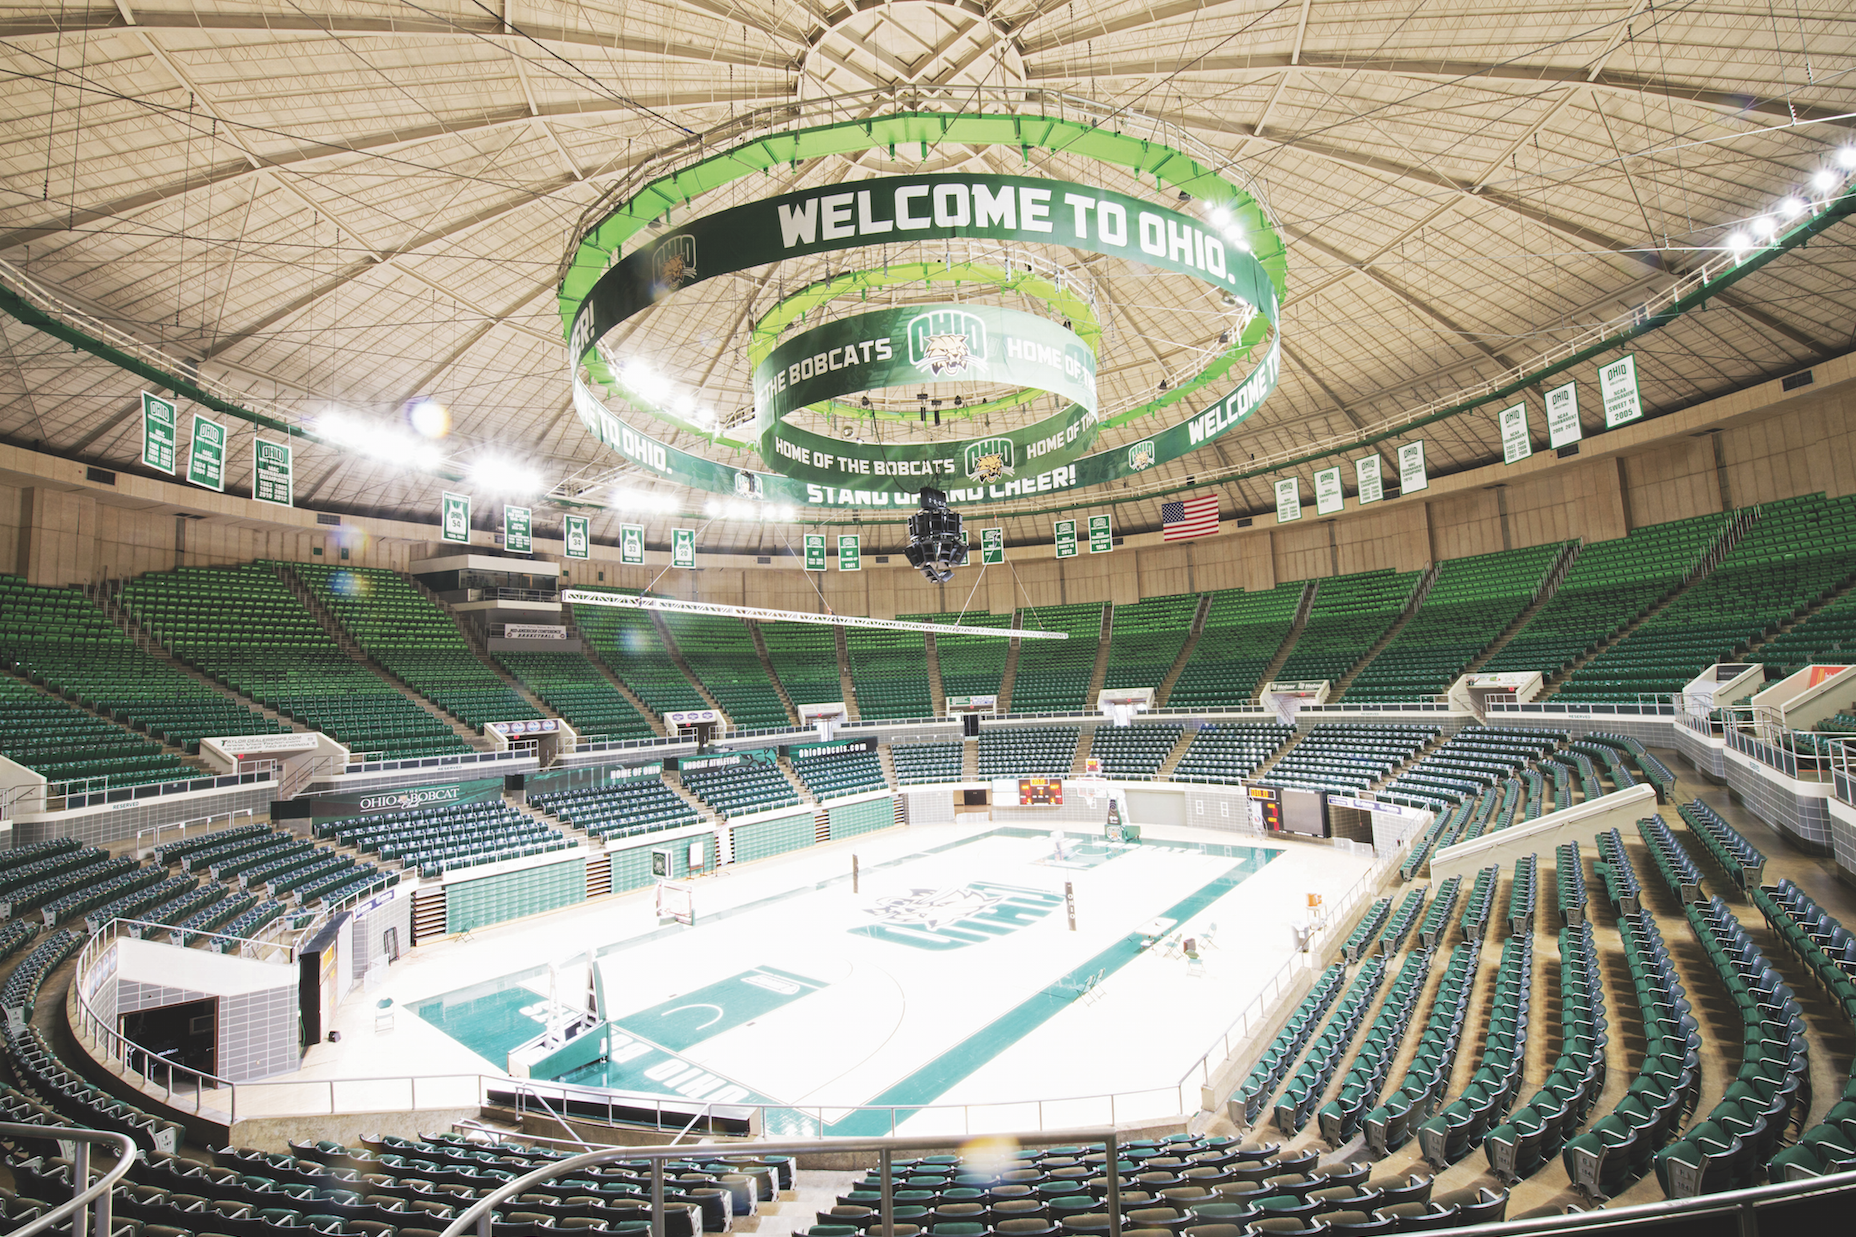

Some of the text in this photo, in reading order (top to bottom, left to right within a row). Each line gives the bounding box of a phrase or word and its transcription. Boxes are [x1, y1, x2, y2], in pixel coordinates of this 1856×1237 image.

[777, 183, 1236, 285] WELCOME TO OHIO.
[907, 309, 988, 366] OHIO
[1007, 337, 1063, 370] HOME
[1065, 355, 1081, 379] OF
[764, 338, 893, 397] THE BOBCATS
[1607, 364, 1627, 381] OHIO
[1552, 389, 1569, 405] OHIO
[1606, 389, 1635, 404] TOURNAMENT
[1613, 387, 1627, 396] NCAA
[150, 401, 169, 422] OHIO
[1188, 366, 1268, 446] WELCOME
[1608, 398, 1635, 413] SWEET 16
[1505, 410, 1519, 424] OHIO
[1550, 413, 1577, 427] TOURNAMENT
[1557, 411, 1568, 419] NCAA
[1614, 408, 1633, 421] 2005
[199, 423, 219, 443] OHIO
[1027, 430, 1065, 460] HOME
[1066, 420, 1080, 444] OF
[598, 407, 673, 475] TO OHIO.
[262, 445, 284, 463] OHIO
[775, 436, 956, 476] HOME OF THE BOBCATS
[964, 437, 1015, 477] OHIO
[1403, 446, 1417, 458] OHIO
[1362, 460, 1374, 471] OHIO
[989, 464, 1076, 497] CHEER!
[1320, 472, 1334, 482] OHIO
[1280, 482, 1293, 492] OHIO
[452, 519, 461, 528] 54
[573, 538, 582, 546] 34
[628, 545, 637, 553] 33
[220, 735, 302, 747] TAYLOR DEALERSHIPS.COM
[799, 743, 867, 759] OhioBobcats.com
[683, 756, 740, 771] BOBCAT ATHLETICS
[610, 765, 660, 780] HOME OF OHIO
[112, 801, 140, 809] RESERVED
[360, 788, 460, 809] OHIO BOBCAT
[1067, 893, 1076, 919] OHIO
